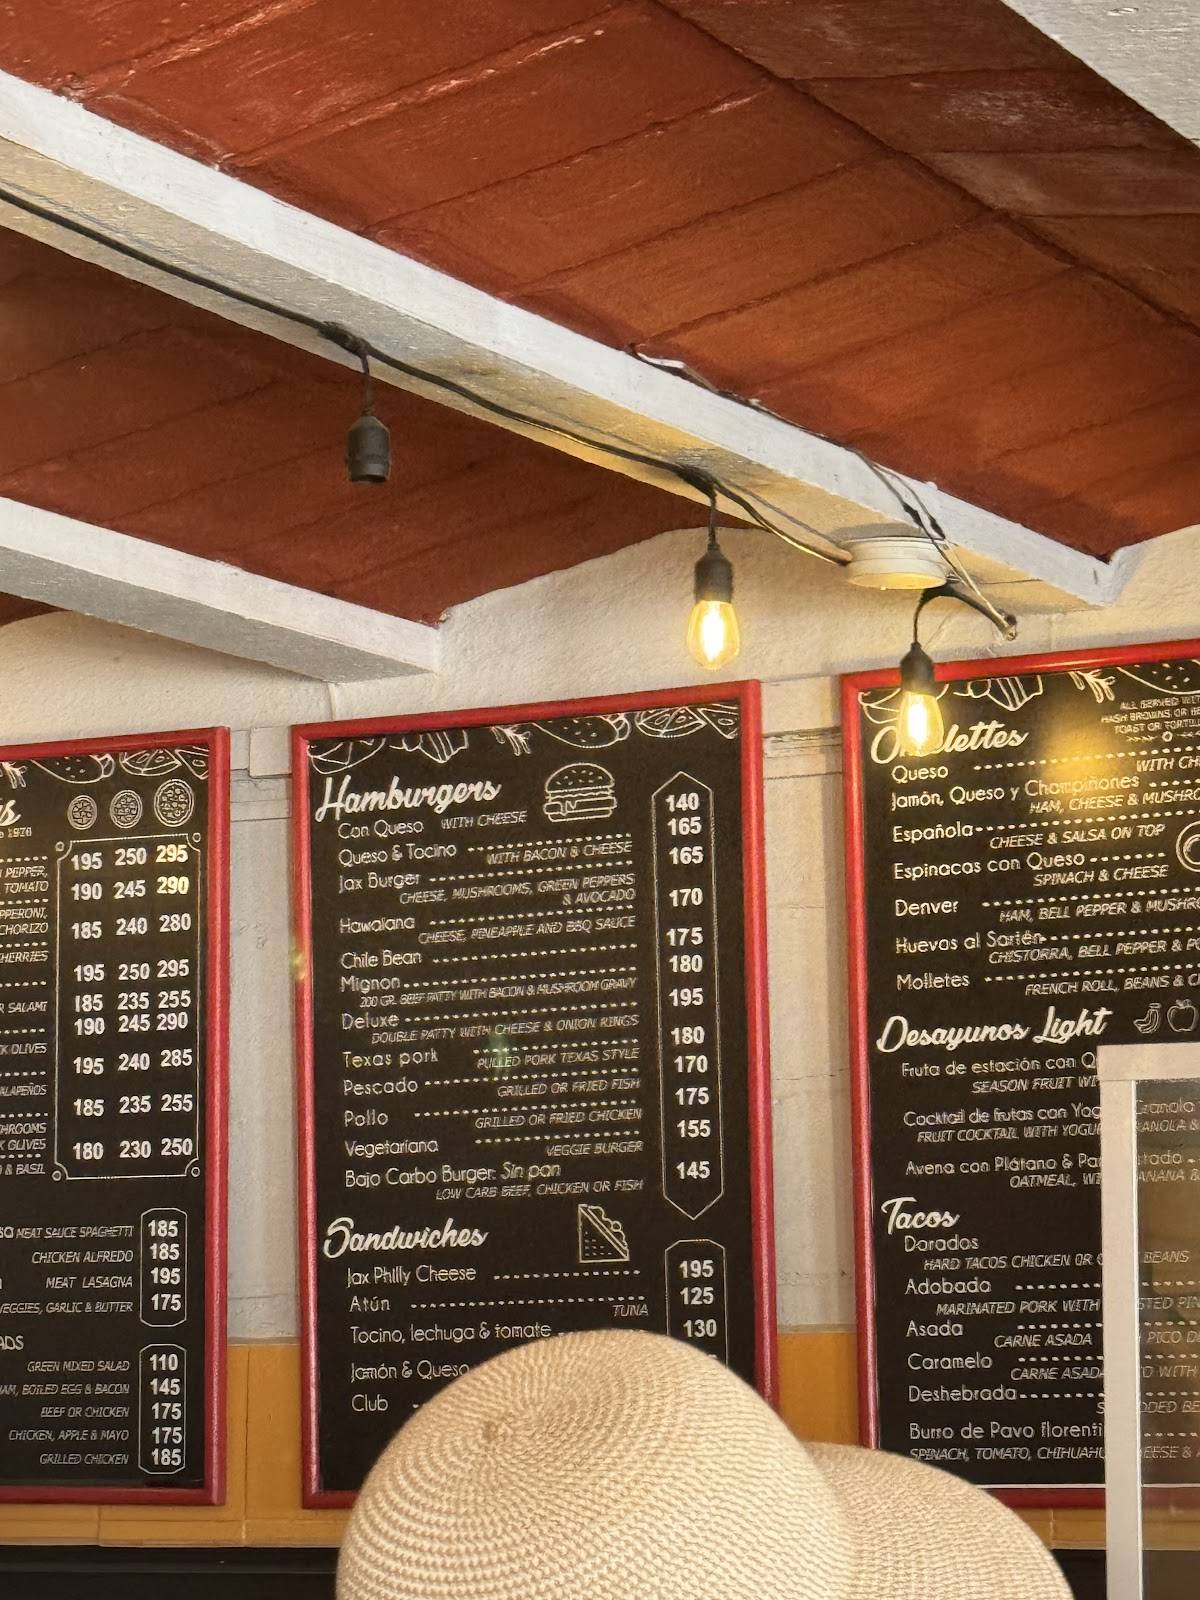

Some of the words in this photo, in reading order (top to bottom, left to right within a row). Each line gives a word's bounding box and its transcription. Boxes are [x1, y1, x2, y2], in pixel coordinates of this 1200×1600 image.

[871, 720, 1029, 764] Olettes
[891, 766, 949, 784] Queso
[1136, 757, 1174, 772] WITH
[315, 775, 502, 822] Hamburgers
[950, 786, 1005, 805] Queso
[1010, 787, 1020, 801] y
[1025, 776, 1140, 797] Champiñones
[666, 793, 699, 812] 140
[338, 823, 369, 839] Con
[374, 820, 424, 838] Queso
[441, 817, 473, 830] WITH
[477, 811, 528, 827] CHEESE
[667, 816, 701, 835] 165
[892, 821, 974, 843] Española
[990, 834, 1043, 849] CHEESE
[1047, 833, 1058, 844] &
[1062, 828, 1107, 844] SALSA
[1111, 826, 1133, 840] ON
[1137, 824, 1165, 837] TOP
[71, 853, 102, 870] 195
[115, 848, 147, 865] 250
[156, 844, 188, 862] 295
[338, 849, 388, 867] Queso
[392, 844, 402, 861] &
[406, 844, 456, 860] Tocino
[669, 846, 703, 865] 165
[894, 859, 981, 880] Espinacas
[987, 858, 1021, 872] con
[1027, 852, 1085, 870] Queso
[1113, 865, 1169, 880] CHEESE
[71, 883, 102, 900] 190
[114, 880, 146, 899] 245
[157, 876, 189, 895] 290
[339, 875, 362, 894] Jax
[368, 872, 420, 890] Burger
[669, 888, 703, 907] 170
[895, 899, 958, 917] Denver
[72, 921, 102, 939] 185
[116, 918, 147, 936] 240
[159, 913, 191, 932] 280
[340, 917, 415, 934] Hawaiana
[666, 927, 703, 946] 175
[964, 932, 981, 950] al
[341, 952, 378, 969] Chile
[383, 949, 422, 965] Bean
[669, 955, 702, 973] 180
[73, 964, 105, 982] 195
[118, 963, 150, 980] 250
[157, 959, 189, 978] 295
[341, 976, 400, 994] Mignon
[897, 972, 970, 990] Molletes
[75, 994, 103, 1012] 185
[118, 992, 149, 1010] 235
[158, 990, 191, 1008] 255
[669, 988, 703, 1007] 195
[74, 1018, 105, 1035] 190
[118, 1015, 150, 1032] 245
[156, 1012, 188, 1030] 290
[342, 1013, 400, 1029] Deluxe
[876, 1015, 1031, 1053] Desayunos
[1032, 1006, 1113, 1045] Light
[671, 1026, 705, 1045] 180
[73, 1057, 104, 1075] 195
[118, 1053, 150, 1071] 240
[160, 1049, 192, 1067] 285
[343, 1052, 391, 1068] Texas
[400, 1049, 438, 1067] pork
[560, 1050, 598, 1063] TEXAS
[602, 1048, 640, 1060] STYLE
[674, 1055, 708, 1073] 170
[902, 1062, 941, 1077] Fruta
[945, 1061, 967, 1075] de
[972, 1058, 1041, 1074] estación
[1045, 1056, 1076, 1070] con
[343, 1078, 418, 1095] Pescado
[551, 1083, 568, 1093] OR
[572, 1080, 607, 1091] FRIED
[612, 1078, 640, 1089] FISH
[73, 1099, 104, 1116] 185
[119, 1096, 151, 1114] 235
[160, 1094, 193, 1112] 255
[675, 1087, 709, 1105] 175
[344, 1110, 388, 1126] Pollo
[677, 1120, 711, 1138] 155
[73, 1143, 103, 1160] 180
[119, 1141, 151, 1158] 230
[160, 1138, 192, 1156] 250
[345, 1140, 438, 1158] Vegetariana
[345, 1170, 380, 1187] Bajo
[386, 1167, 436, 1185] Carbo
[501, 1162, 523, 1178] Sin
[528, 1165, 561, 1181] pan
[676, 1161, 710, 1180] 145
[880, 1196, 960, 1235] Tacos
[148, 1220, 179, 1237] 185
[323, 1217, 490, 1258] Sandwiches
[150, 1243, 179, 1261] 185
[904, 1234, 980, 1252] Dorados
[32, 1251, 80, 1263] CHICKEN
[84, 1250, 133, 1262] ALFREDO
[150, 1267, 180, 1285] 195
[346, 1268, 370, 1288] Jax
[375, 1266, 411, 1286] Philly
[416, 1265, 477, 1282] Cheese
[679, 1260, 714, 1278] 195
[46, 1276, 77, 1288] MEAT
[905, 1276, 992, 1295] Adobada
[151, 1294, 181, 1311] 175
[350, 1296, 390, 1312] Atún
[680, 1287, 714, 1305] 125
[613, 1304, 649, 1317] TUNA
[1019, 1300, 1058, 1314] PORK
[1062, 1299, 1100, 1312] WITH
[350, 1327, 405, 1344] Tocino,
[411, 1324, 475, 1343] lechuga
[479, 1322, 490, 1338] &
[495, 1321, 551, 1338] tomate
[682, 1319, 717, 1338] 130
[905, 1319, 964, 1337] Asada
[994, 1334, 1042, 1348] CARNE
[1045, 1333, 1093, 1346] ASADA
[150, 1354, 178, 1371] 110
[907, 1352, 993, 1370] Caramelo
[351, 1362, 397, 1383] Jamón
[402, 1360, 413, 1378] &
[417, 1360, 470, 1380] Queso
[1010, 1367, 1059, 1381] CARNE
[150, 1378, 180, 1396] 145
[908, 1384, 1017, 1403] Deshebrada
[152, 1403, 181, 1420] 175
[351, 1394, 389, 1412] Club
[152, 1427, 182, 1444] 175
[909, 1422, 954, 1440] Burro
[960, 1422, 985, 1439] de
[990, 1422, 1035, 1438] Pavo
[152, 1448, 181, 1466] 185
